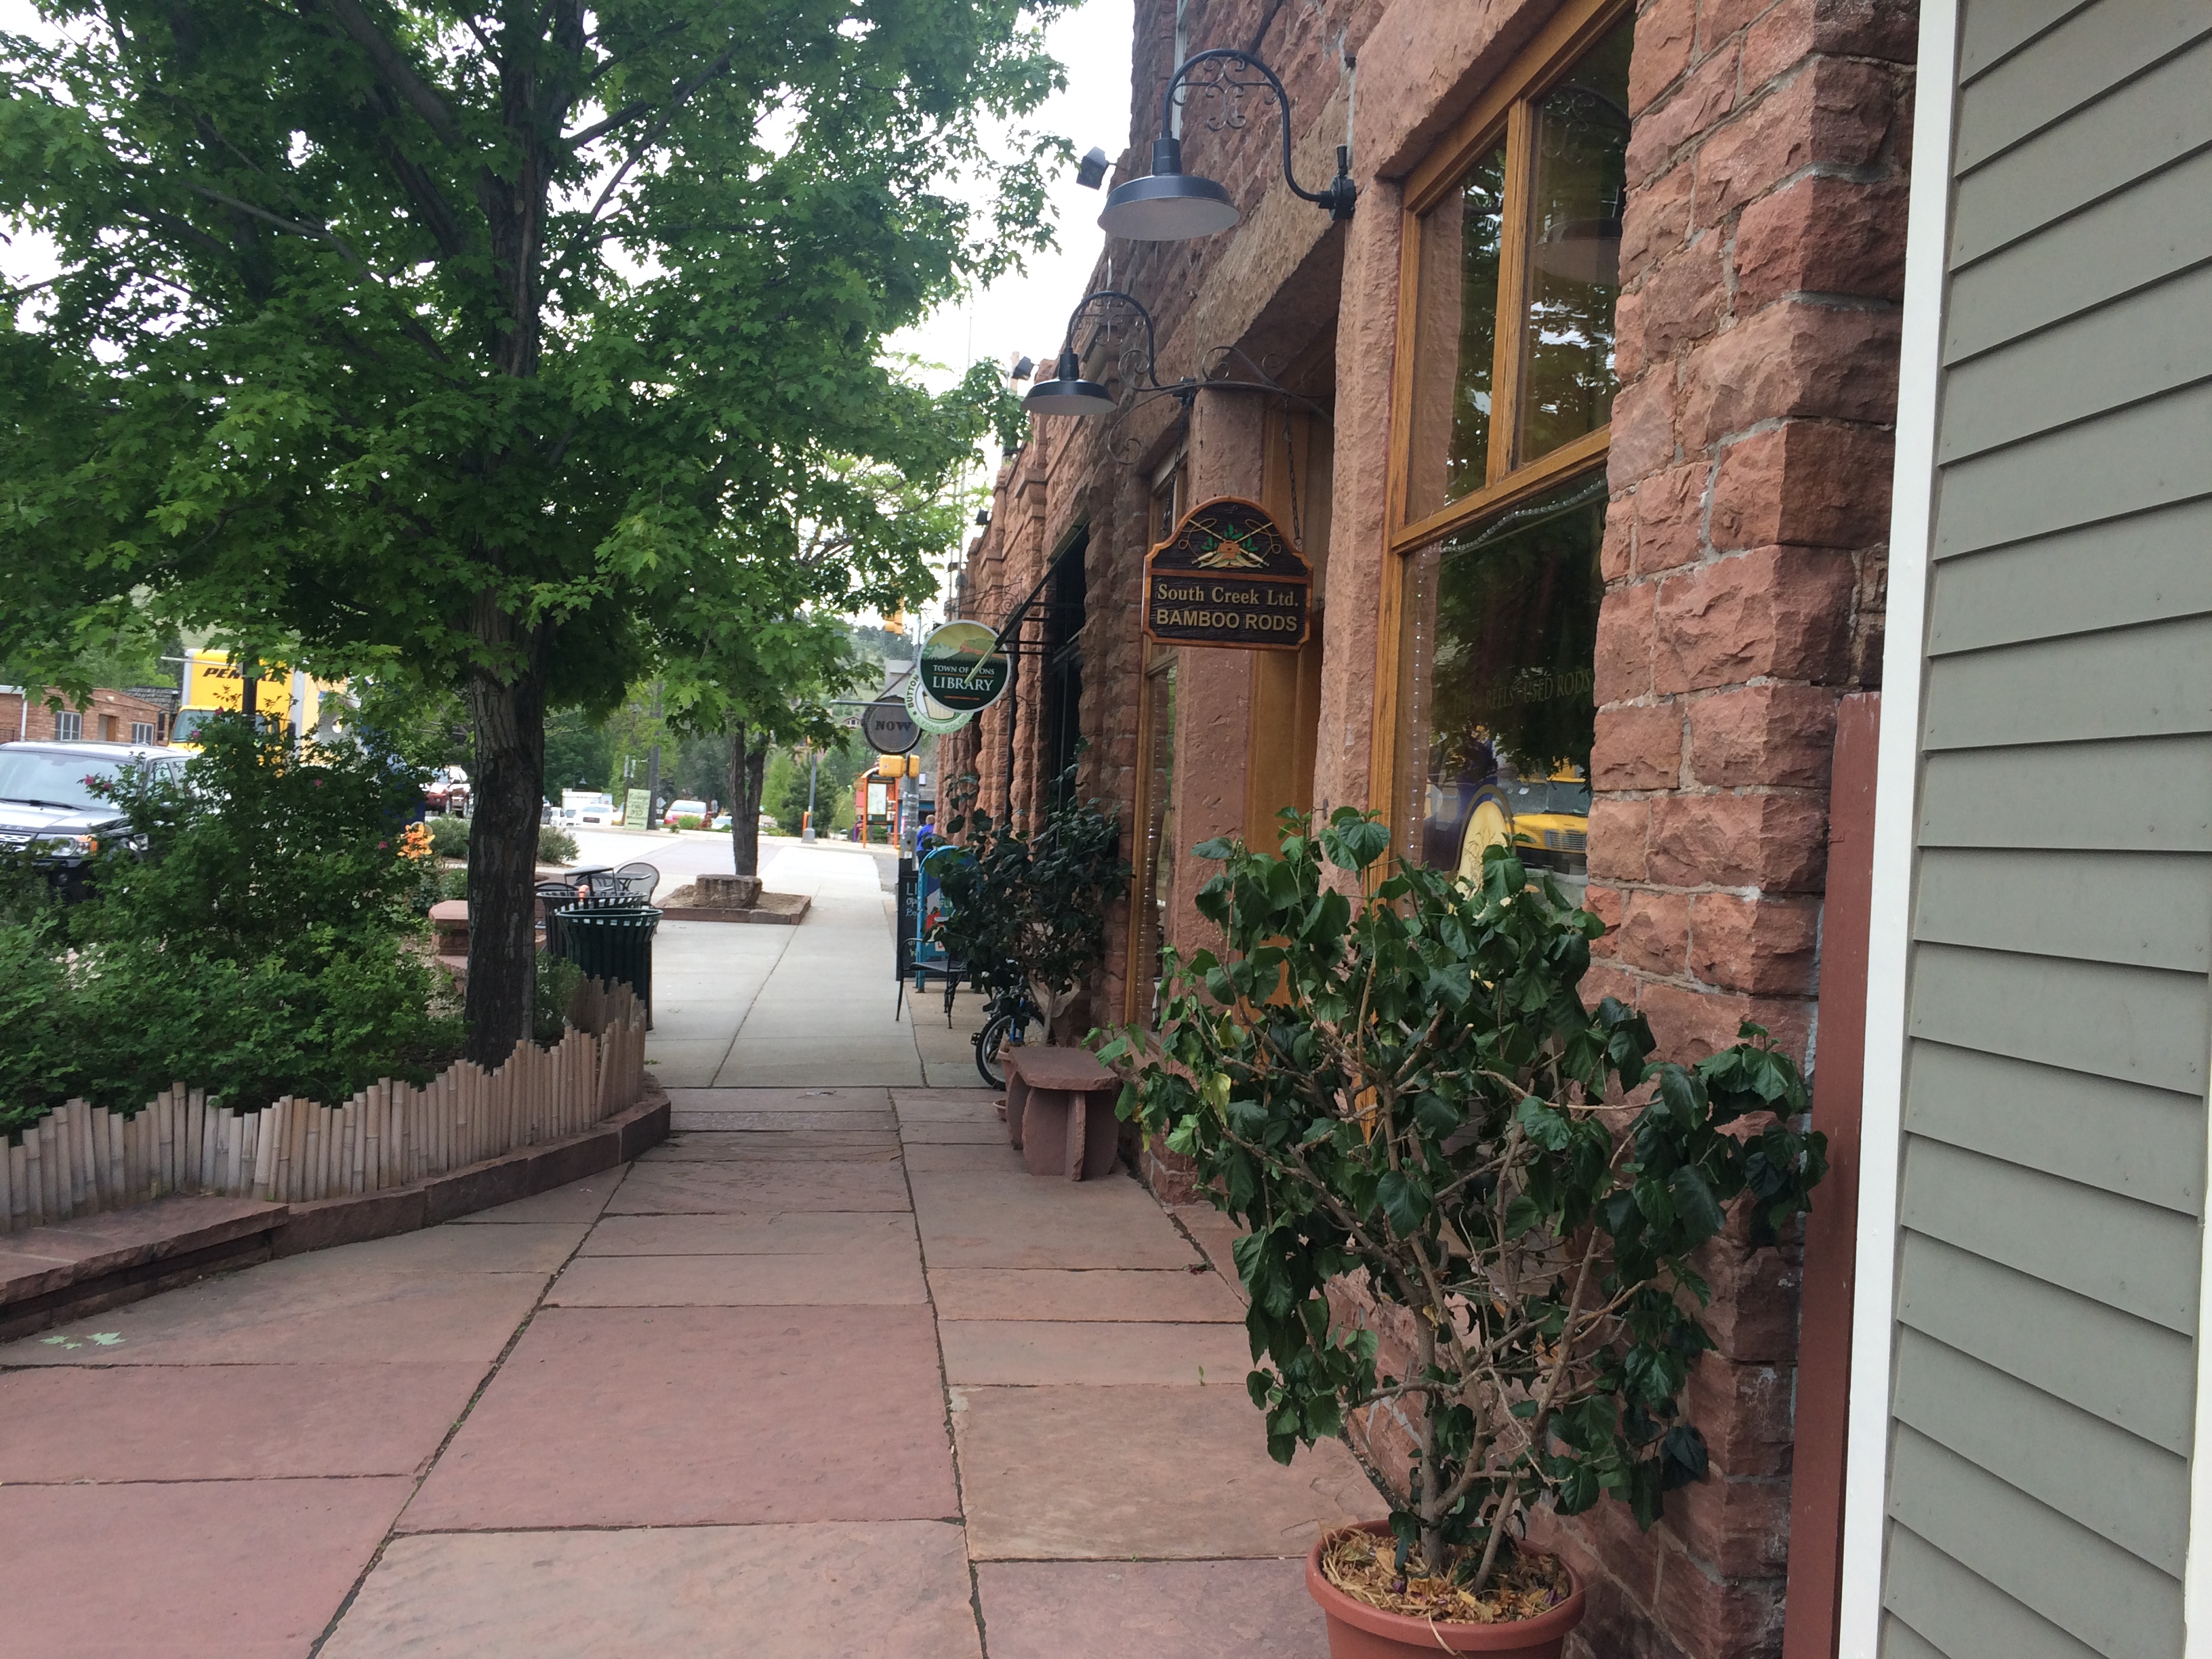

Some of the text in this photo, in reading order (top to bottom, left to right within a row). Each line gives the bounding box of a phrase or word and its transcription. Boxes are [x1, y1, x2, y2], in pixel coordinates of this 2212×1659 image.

[1157, 583, 1298, 607] South Creek Ltd.
[1156, 609, 1297, 631] BAMBOO RODS
[971, 667, 995, 675] ONS
[906, 674, 920, 709] BUTTON
[933, 676, 994, 691] LIBRARY
[1486, 686, 1514, 710] REELS
[1523, 676, 1553, 703] USED
[1557, 668, 1591, 698] RODS
[875, 720, 913, 732] NOW
[945, 713, 969, 731] COLOR
